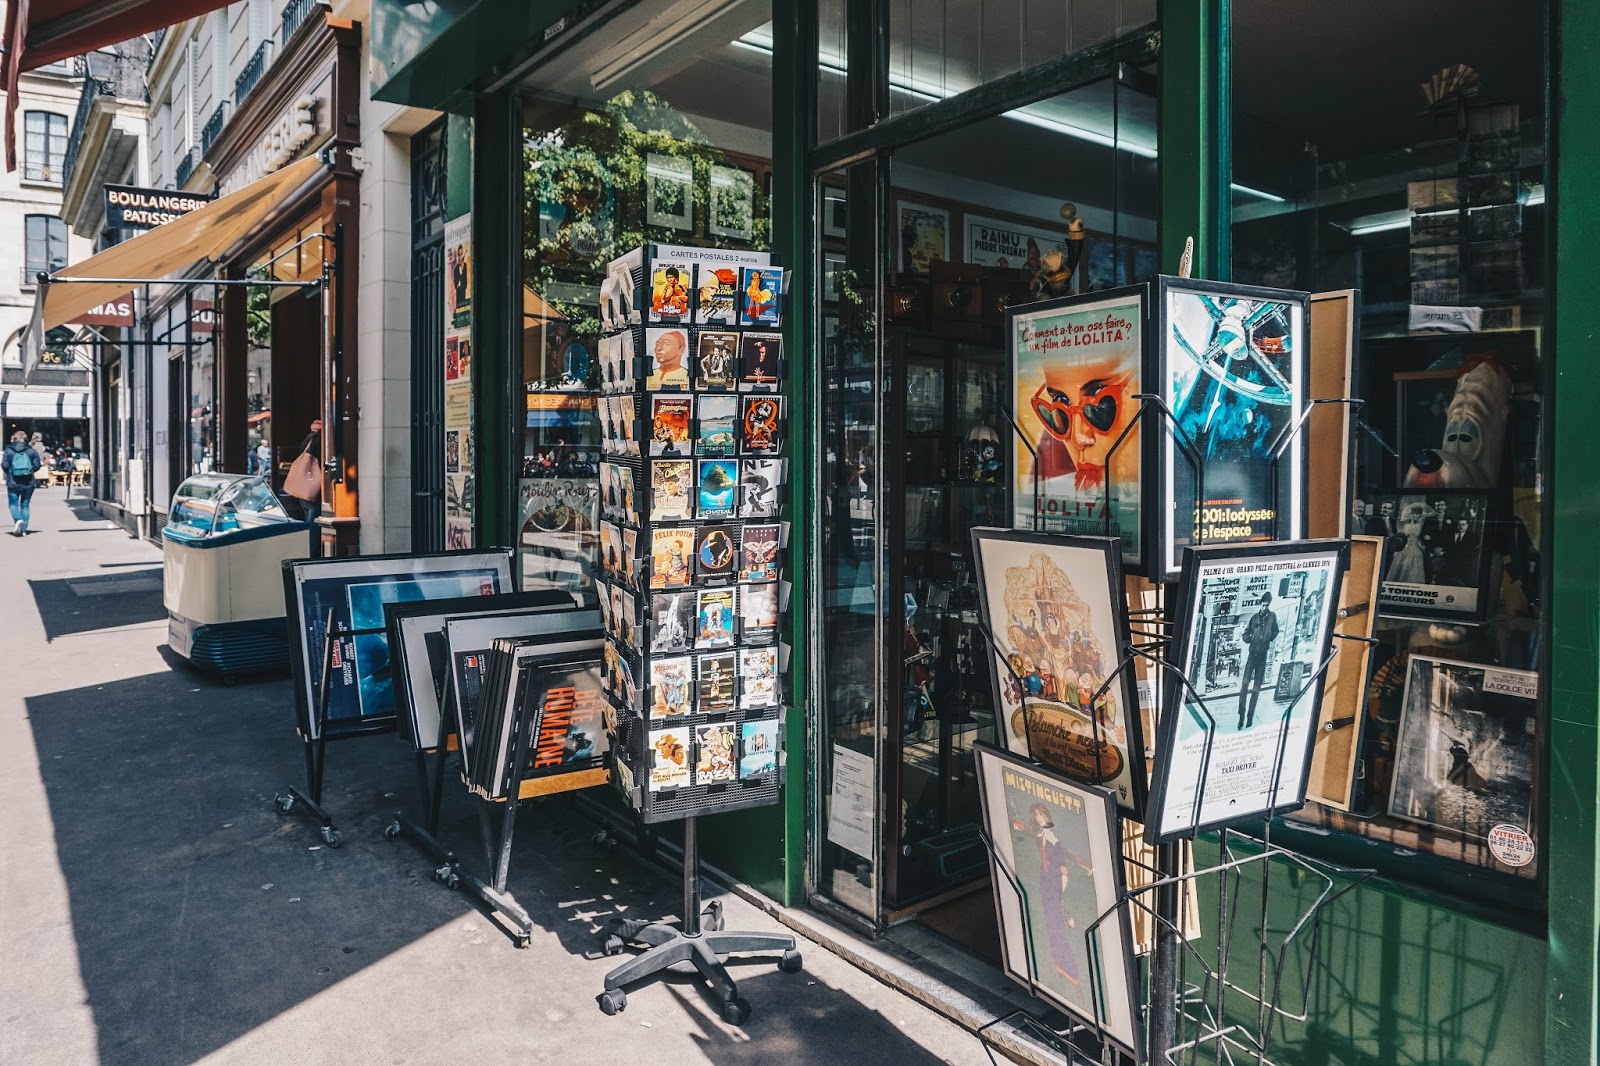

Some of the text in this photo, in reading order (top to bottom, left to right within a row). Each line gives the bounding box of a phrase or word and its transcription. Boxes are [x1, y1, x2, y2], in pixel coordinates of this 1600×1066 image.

[123, 209, 182, 225] PATISSE
[981, 228, 1022, 247] RAIMU
[670, 250, 698, 259] CARTES
[699, 252, 734, 262] POSTALES
[974, 240, 1027, 259] PIERRE FRESNAY
[1021, 325, 1059, 343] Comment
[1087, 319, 1104, 332] osé
[1105, 313, 1126, 332] faire
[1029, 342, 1040, 351] un
[1041, 338, 1059, 354] film
[1061, 336, 1072, 347] de
[1074, 329, 1124, 347] LOLITA
[1037, 498, 1114, 519] LOLITA
[1203, 567, 1221, 576] PALME
[1237, 565, 1254, 573] GRAND
[1255, 564, 1268, 572] PRIX
[1273, 562, 1296, 571] FESTIVAL
[1302, 560, 1321, 569] CANNES
[1246, 583, 1267, 591] MOVIES
[1250, 575, 1268, 584] ADULT
[1381, 594, 1436, 605] INGUEURS
[1388, 587, 1439, 598] TONTONS
[1485, 681, 1538, 696] LA DOLCE VIT
[1492, 677, 1517, 685] FEDERICO
[534, 686, 575, 769] HUMAINE
[1028, 709, 1072, 742] Blanche
[1221, 762, 1257, 775] TAXI DRIVER
[1005, 771, 1082, 816] MISTINGUETT
[1494, 830, 1528, 841] VITRIER
